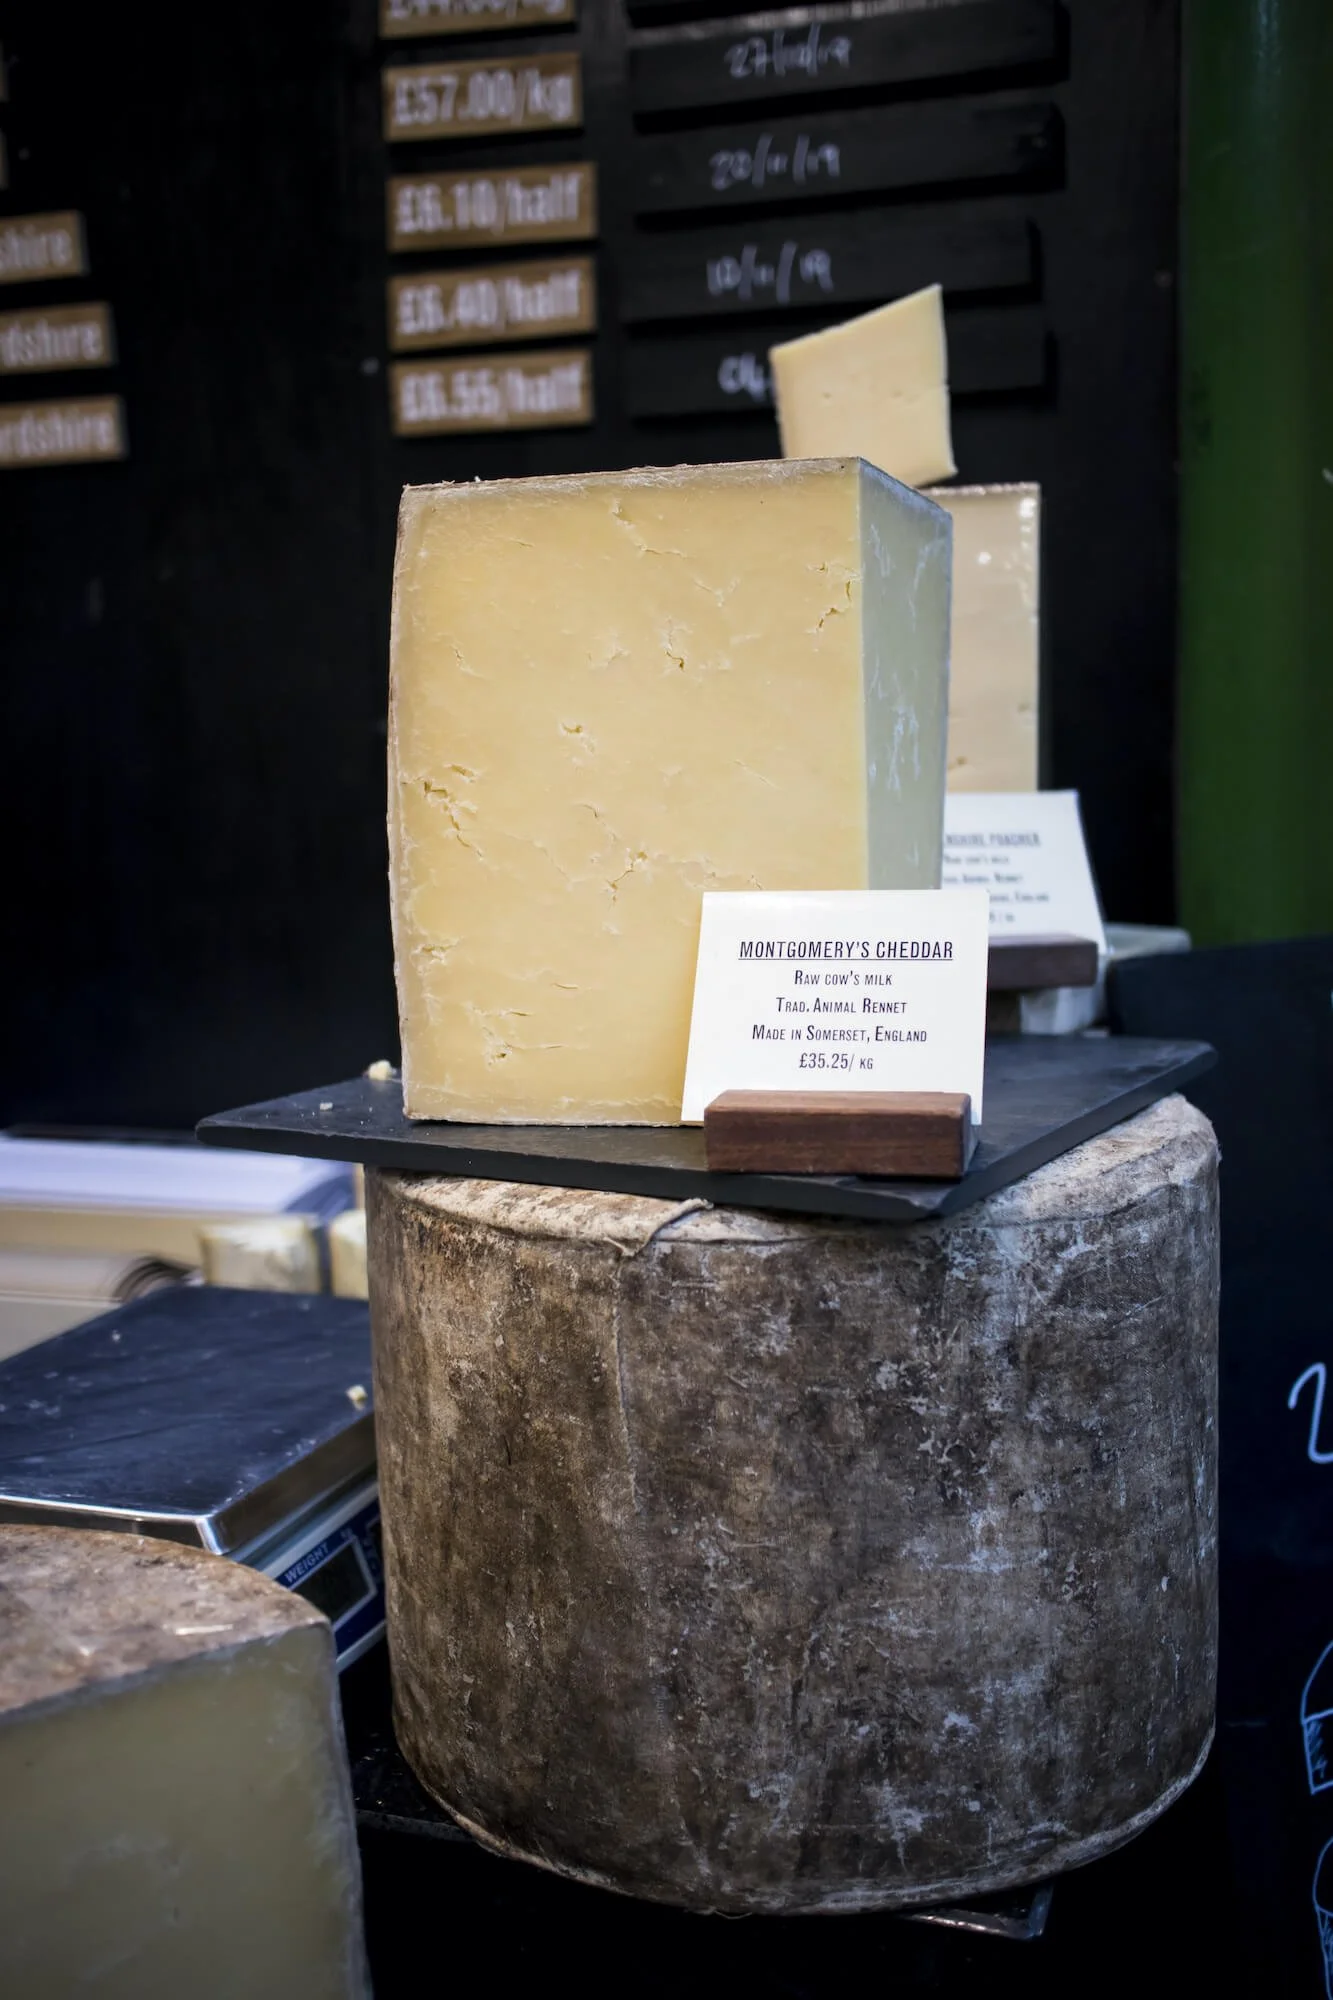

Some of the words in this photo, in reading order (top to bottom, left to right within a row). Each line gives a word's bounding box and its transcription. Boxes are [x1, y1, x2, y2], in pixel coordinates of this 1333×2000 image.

[394, 67, 574, 126] £57.00/kg
[739, 941, 870, 958] MONTGOMERY'S
[876, 941, 953, 958] CHEDDAR
[864, 974, 892, 986] MILK
[284, 1542, 329, 1583] WEIGHT
